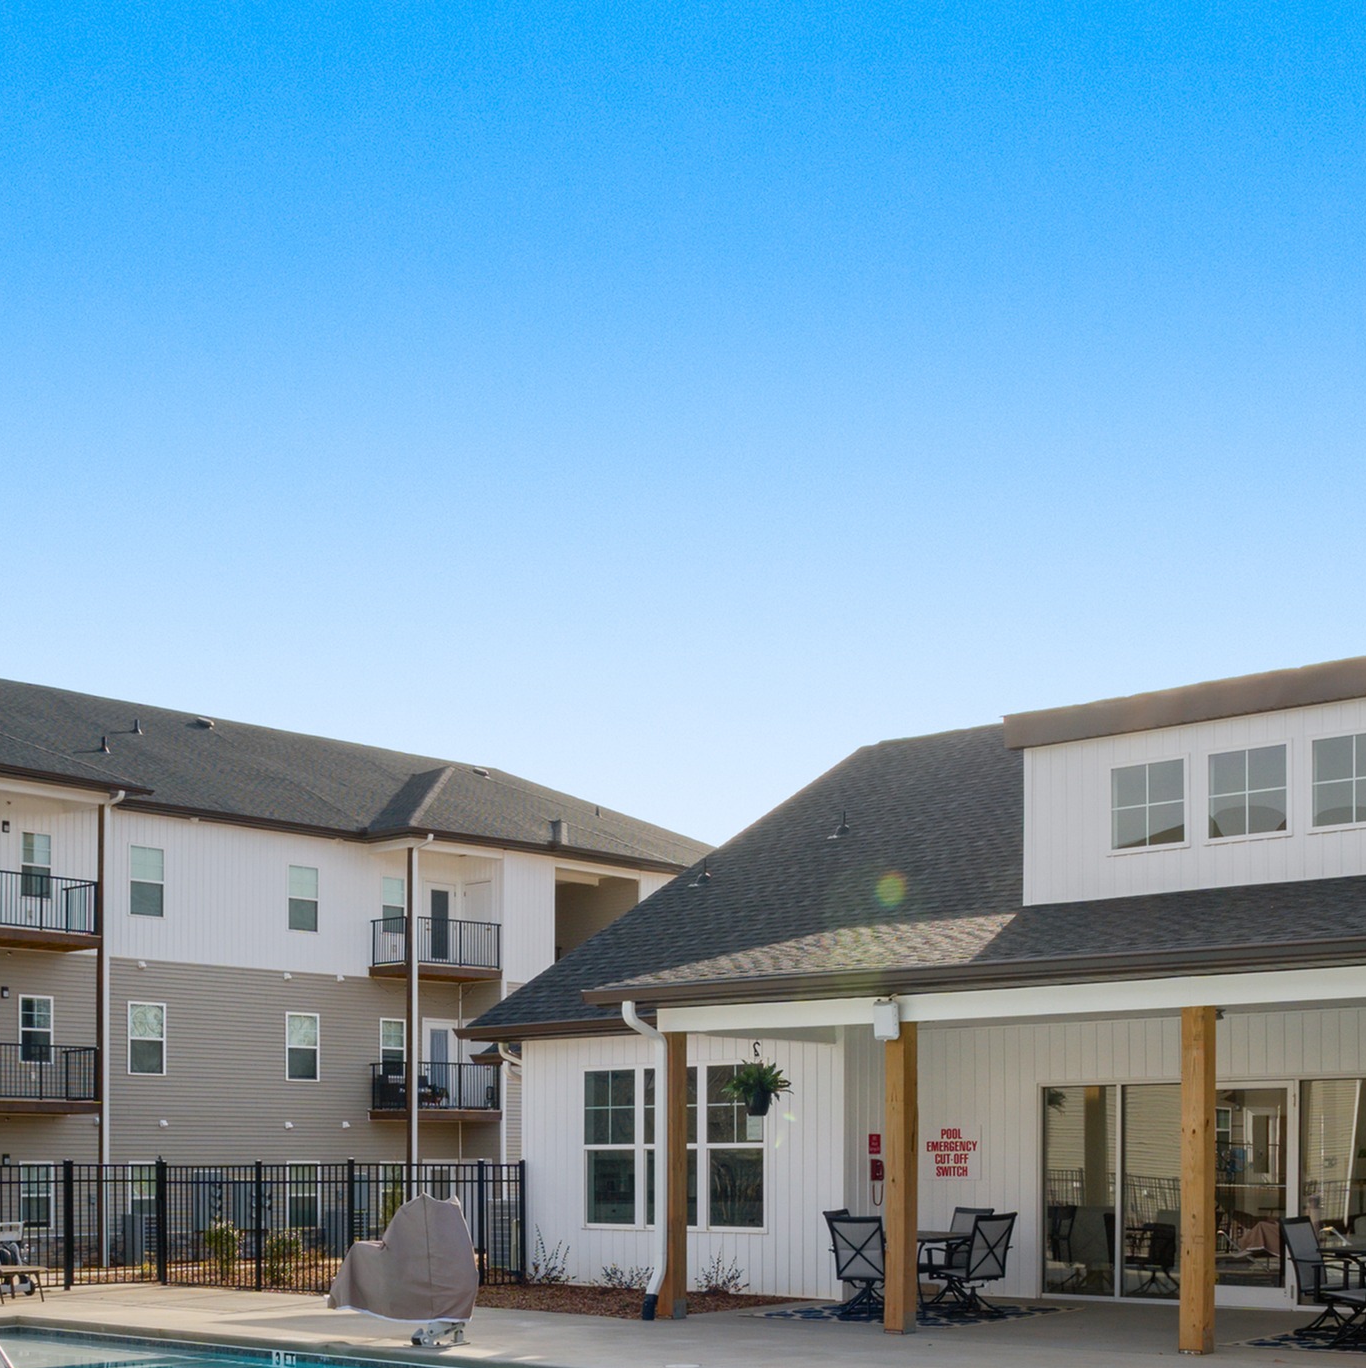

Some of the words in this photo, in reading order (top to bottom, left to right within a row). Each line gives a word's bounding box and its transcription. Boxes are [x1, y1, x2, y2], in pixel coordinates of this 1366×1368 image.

[941, 1128, 962, 1140] POOL
[926, 1141, 977, 1152] EMERGENCY
[935, 1153, 969, 1164] CUT-OFF
[936, 1166, 968, 1177] SWITCH
